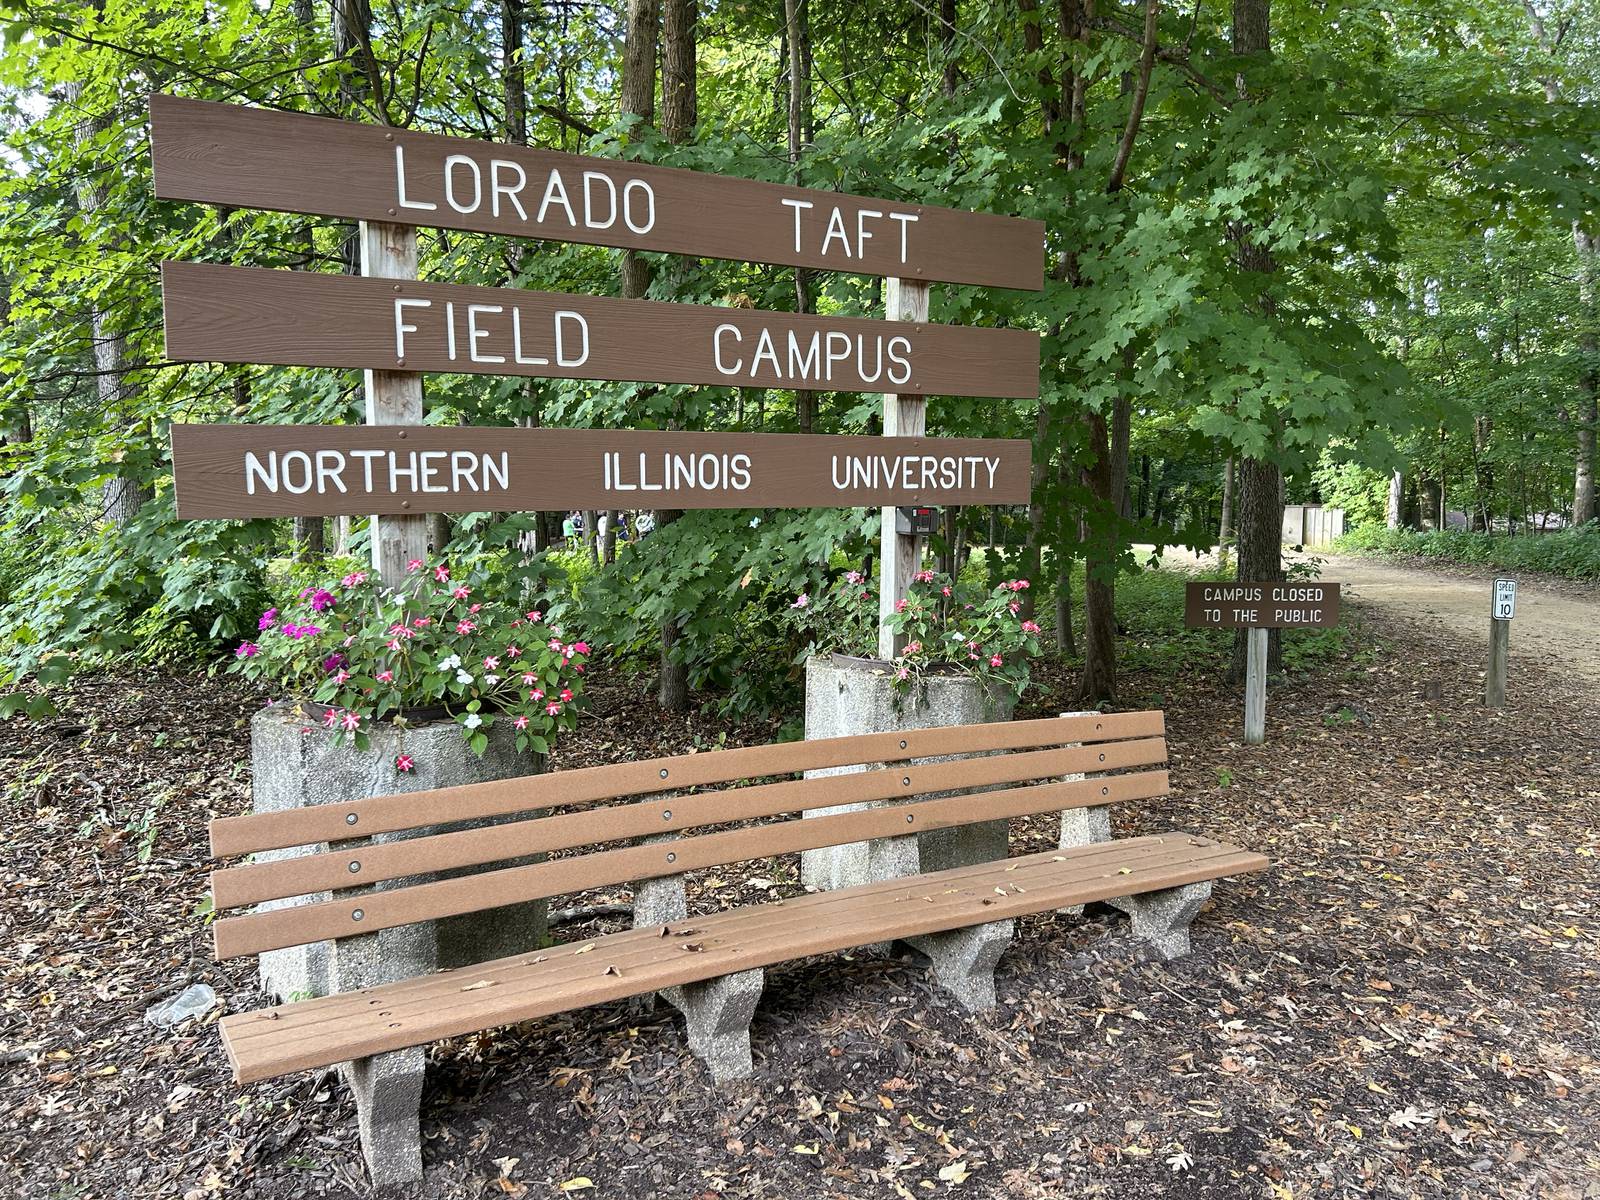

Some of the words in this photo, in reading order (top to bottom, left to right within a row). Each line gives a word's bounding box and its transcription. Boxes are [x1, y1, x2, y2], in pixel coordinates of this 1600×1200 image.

[395, 145, 655, 235] LORADO
[781, 198, 919, 264] TAFT
[394, 298, 590, 368] FIELD
[714, 323, 912, 385] CAMPUS
[245, 449, 509, 495] NORTHERN
[604, 452, 752, 491] ILLINOIS
[832, 455, 1000, 490] UNIVERSITY
[1204, 587, 1262, 602] CAMPUS
[1272, 588, 1323, 602] CLOSED
[1498, 583, 1514, 592] SPEED
[1500, 594, 1513, 602] LIMIT
[1204, 609, 1221, 622] TO
[1233, 609, 1258, 622] THE
[1275, 609, 1322, 622] PUBLIC
[1500, 604, 1511, 615] 10
